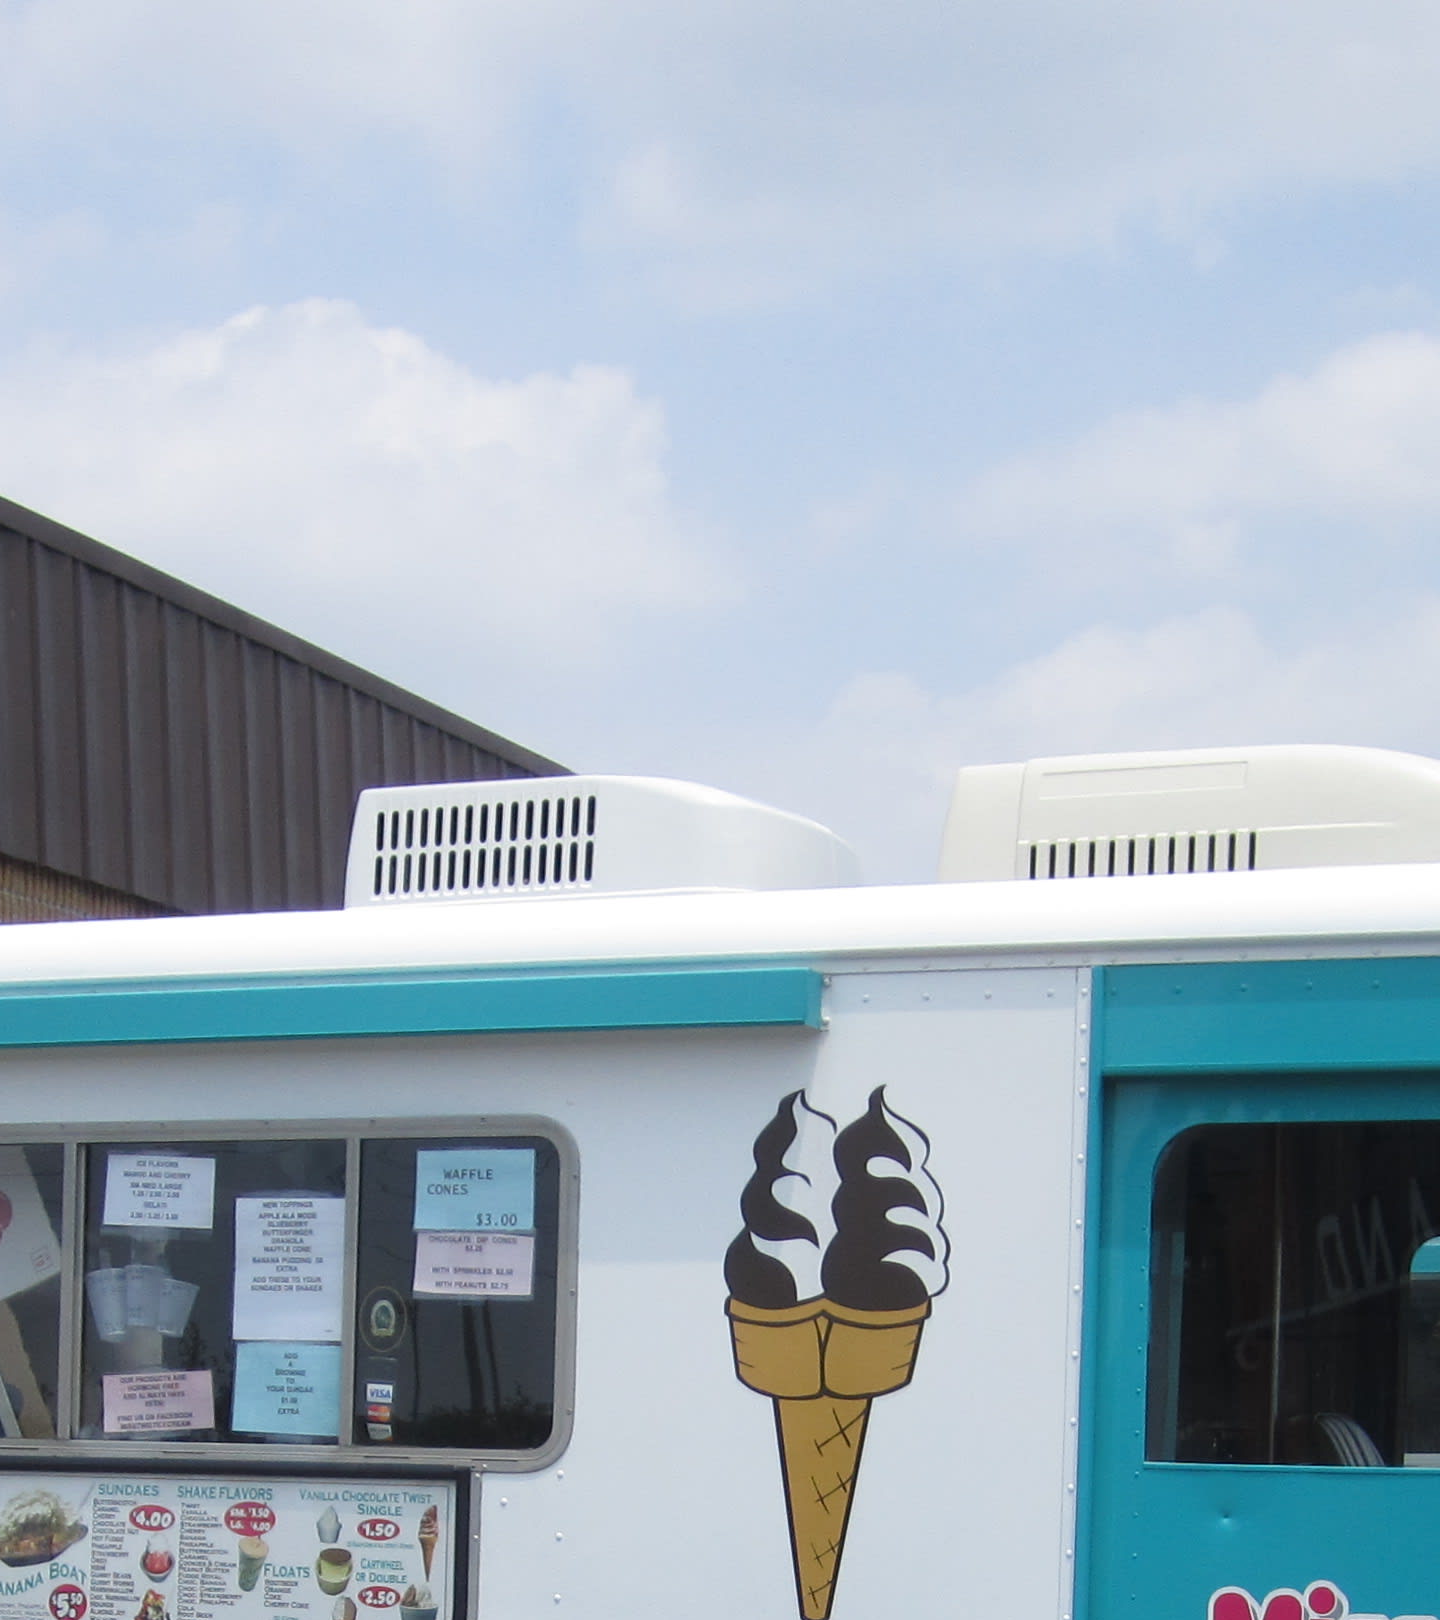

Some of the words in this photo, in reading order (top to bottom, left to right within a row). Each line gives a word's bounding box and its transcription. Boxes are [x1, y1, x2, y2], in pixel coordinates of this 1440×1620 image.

[443, 1169, 494, 1180] WAFFLE
[427, 1184, 468, 1195] CONES
[476, 1213, 517, 1226] $3.00
[429, 1236, 471, 1244] CHOCOLATE
[454, 1281, 487, 1289] PEANUTS
[369, 1388, 391, 1399] VISA
[99, 1483, 159, 1496] SUNDAES
[177, 1486, 216, 1499] SHAKE
[219, 1487, 272, 1500] FLAVORS
[299, 1489, 339, 1500] VANILLA
[342, 1490, 399, 1503] CHOCOLATE
[401, 1492, 432, 1504] TWIST
[357, 1504, 402, 1516] SINGLE
[361, 1558, 404, 1570] CARTWHEEL
[50, 1562, 87, 1584] BOAT
[264, 1563, 310, 1578] FLOATS
[355, 1572, 366, 1581] OR
[369, 1572, 407, 1584] DOUBLE
[362, 1590, 395, 1605] $2.50
